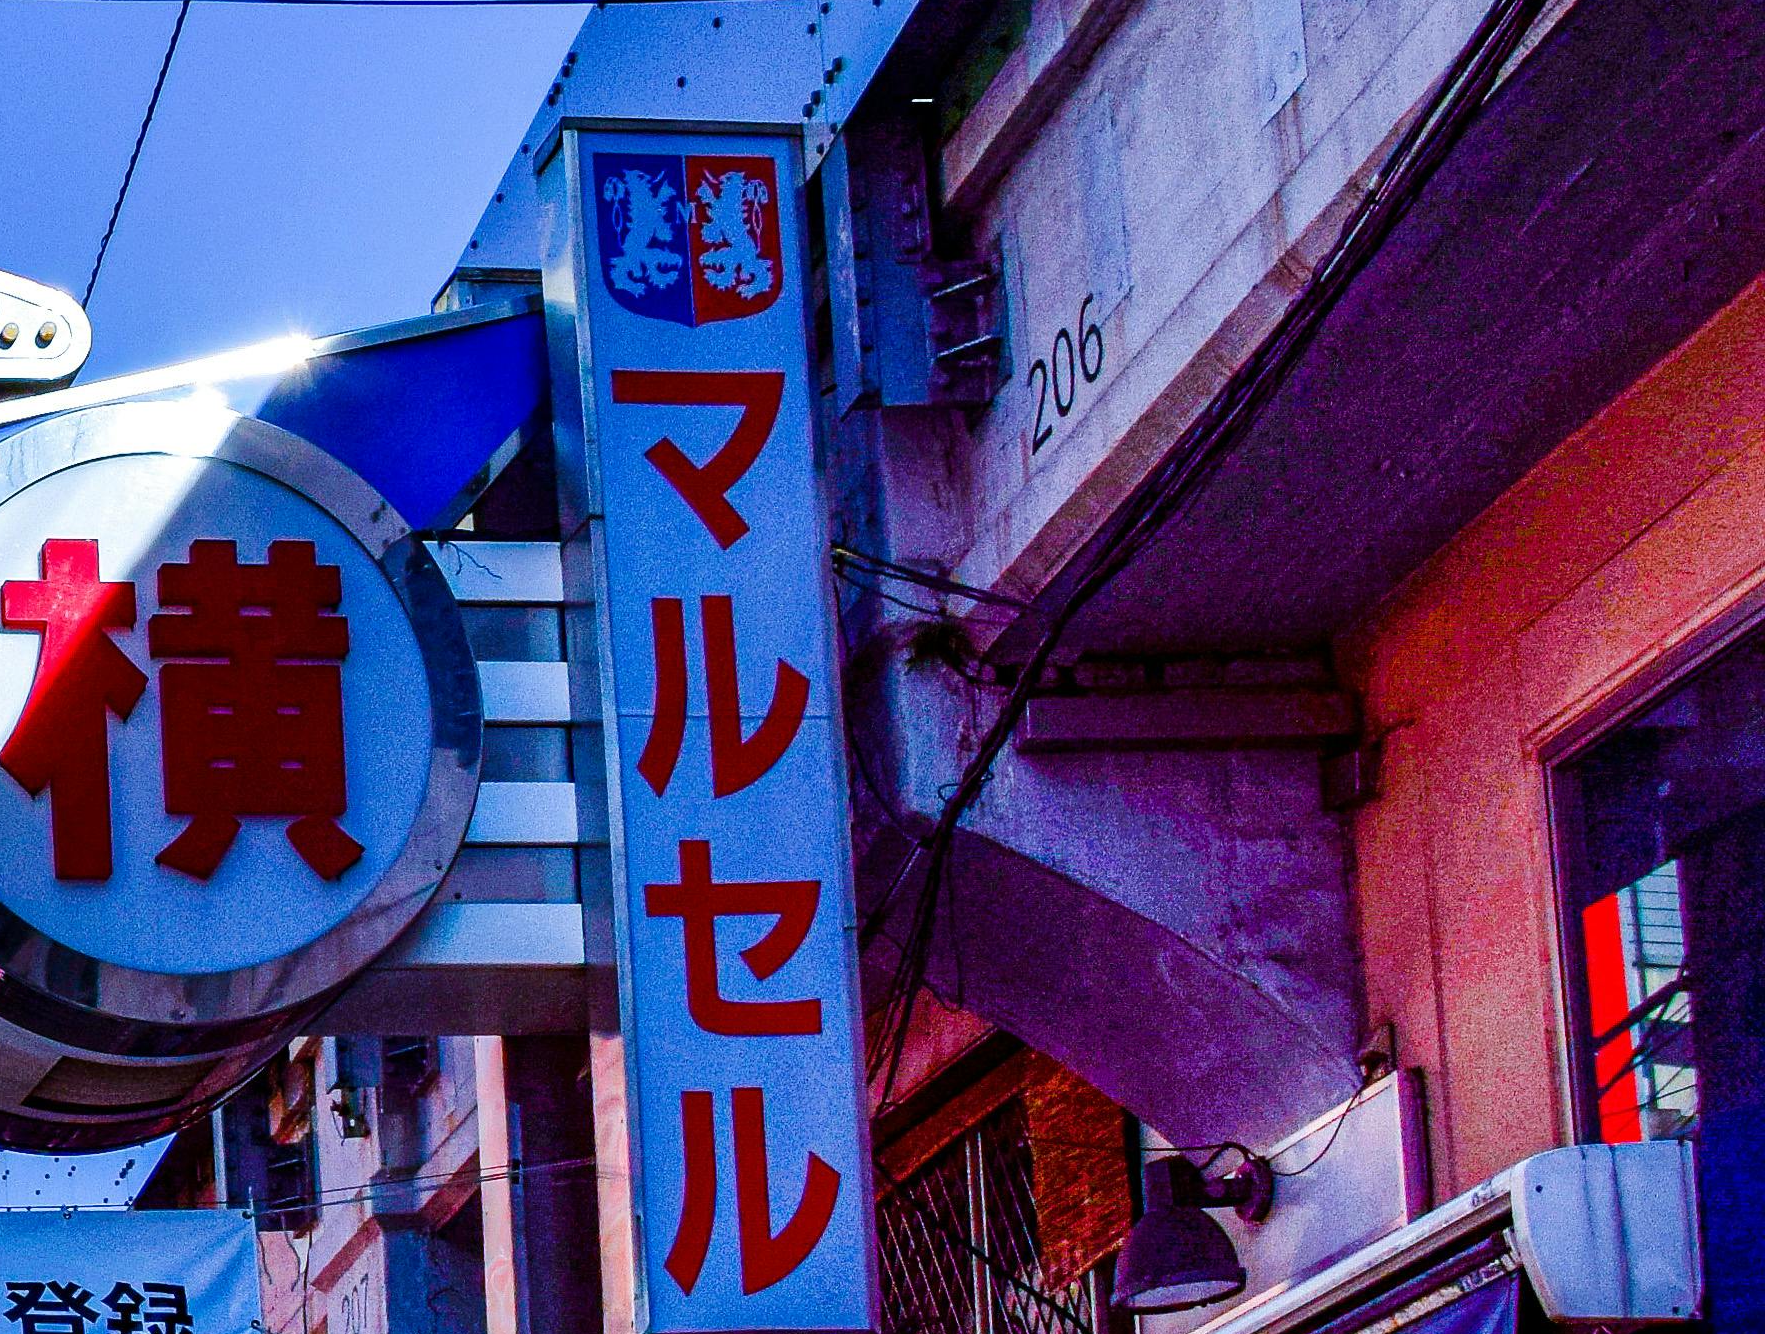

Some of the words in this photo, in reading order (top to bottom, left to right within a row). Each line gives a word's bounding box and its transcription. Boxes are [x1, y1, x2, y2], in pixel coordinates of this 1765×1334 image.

[1027, 292, 1106, 454] 206
[611, 370, 841, 1295] マルセル
